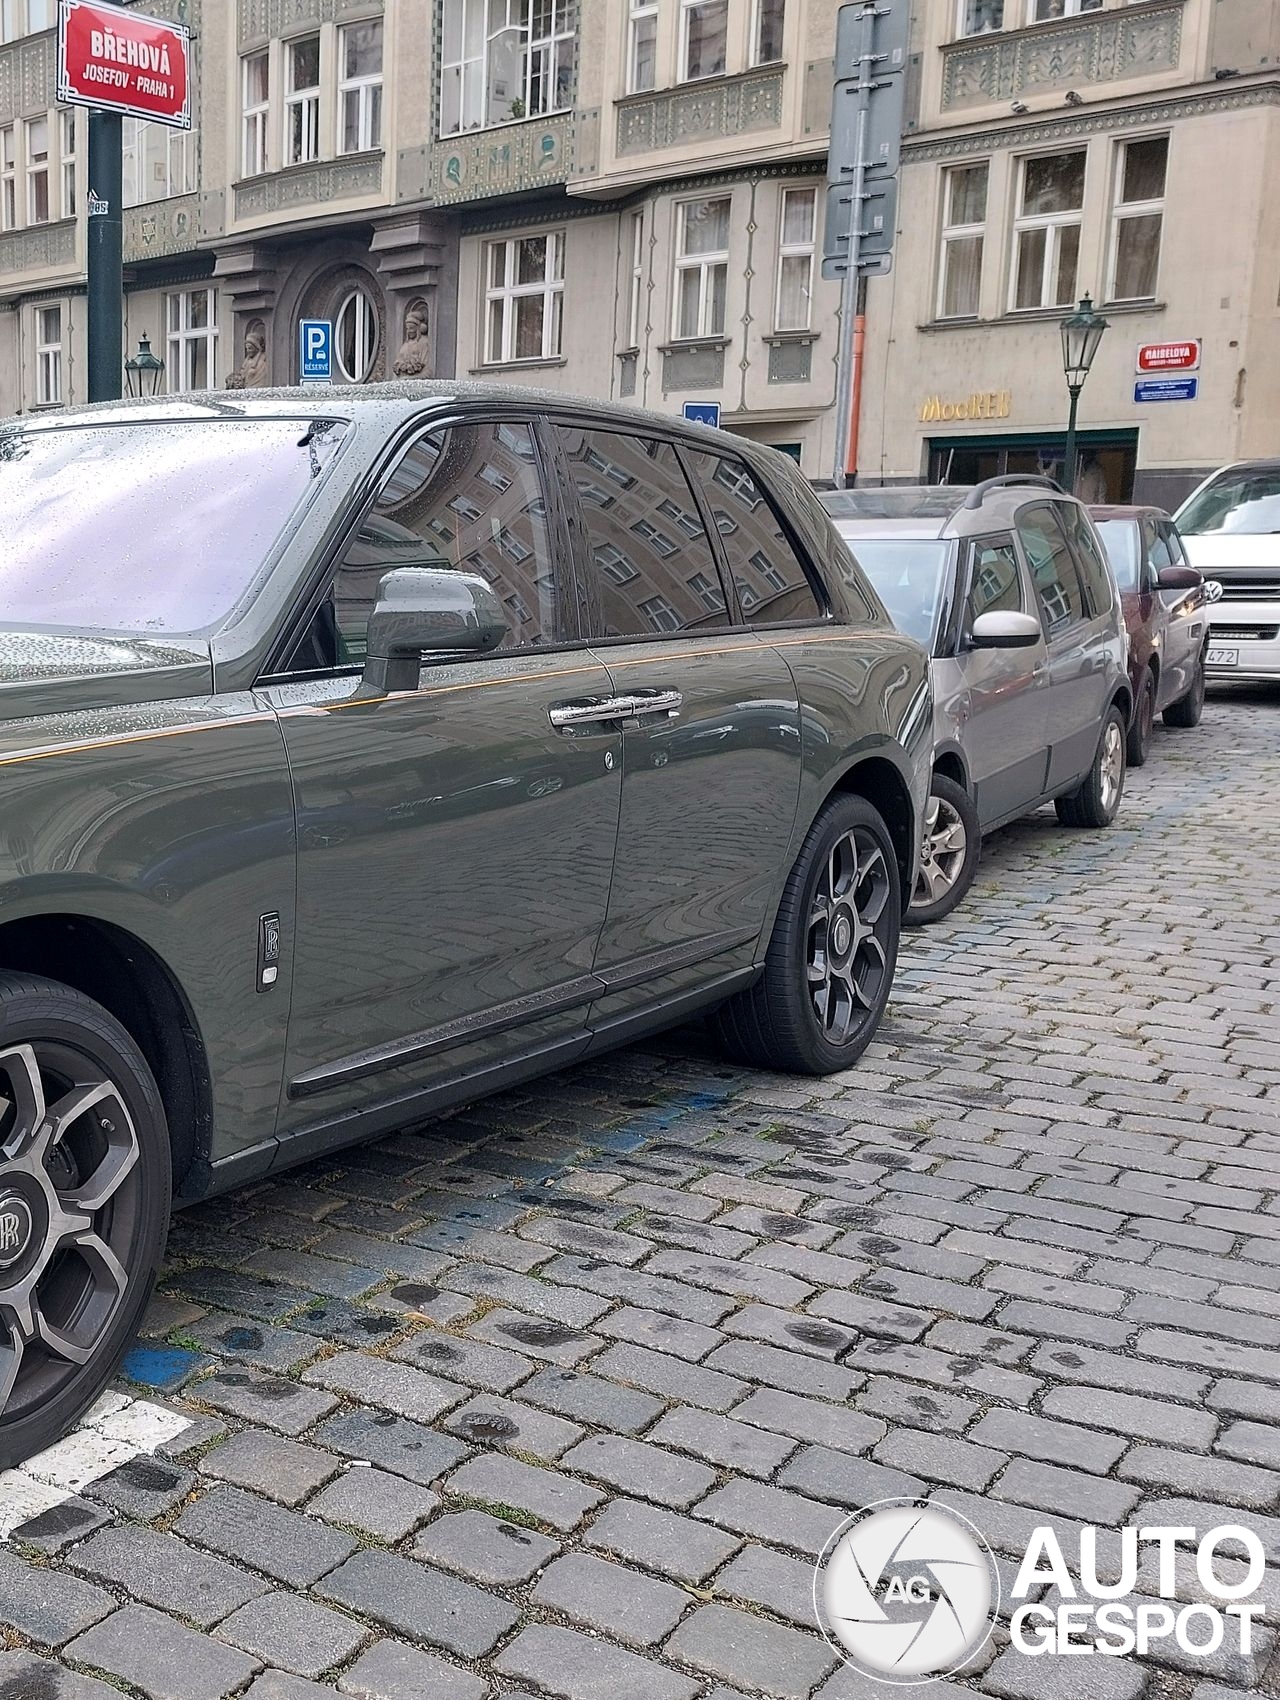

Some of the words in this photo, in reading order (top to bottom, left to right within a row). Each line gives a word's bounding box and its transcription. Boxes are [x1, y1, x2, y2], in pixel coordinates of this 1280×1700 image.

[91, 27, 171, 76] BŘEHOVÁ
[82, 63, 130, 89] JOSEFOV
[137, 76, 168, 98] PRAHA
[169, 85, 174, 100] 1
[308, 327, 325, 360] P
[0, 1212, 20, 1251] RR
